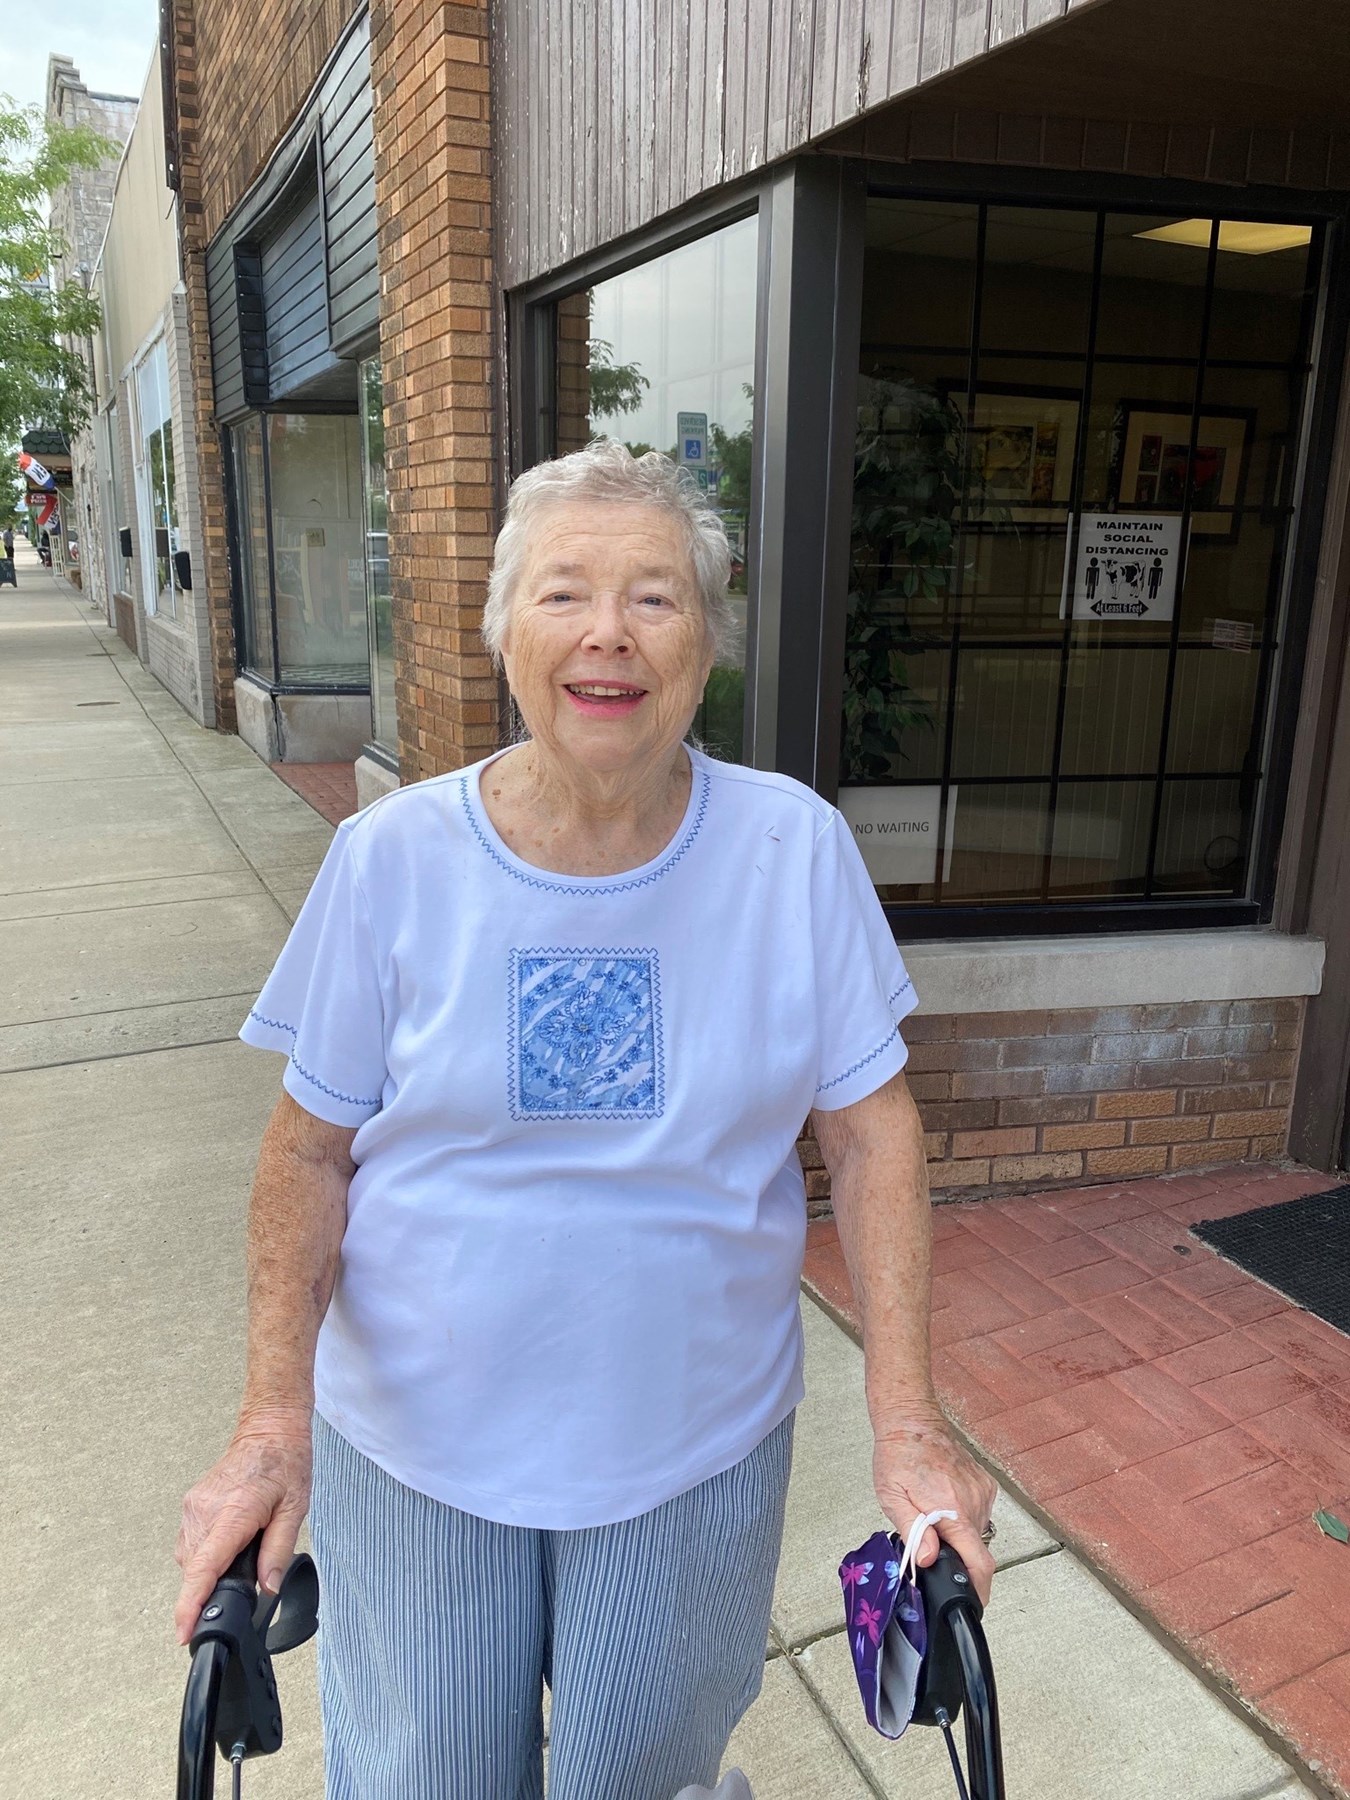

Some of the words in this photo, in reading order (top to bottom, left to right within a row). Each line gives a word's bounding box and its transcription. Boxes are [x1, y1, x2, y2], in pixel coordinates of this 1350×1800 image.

[1096, 521, 1163, 531] MAINTAIN
[1103, 534, 1154, 543] SOCIAL
[1085, 546, 1169, 556] DISTANCING
[1095, 603, 1103, 613] At
[1104, 603, 1122, 613] Least
[1123, 604, 1128, 613] 6
[1128, 604, 1143, 613] Feet
[855, 823, 873, 834] NO
[877, 821, 930, 833] WAITING
